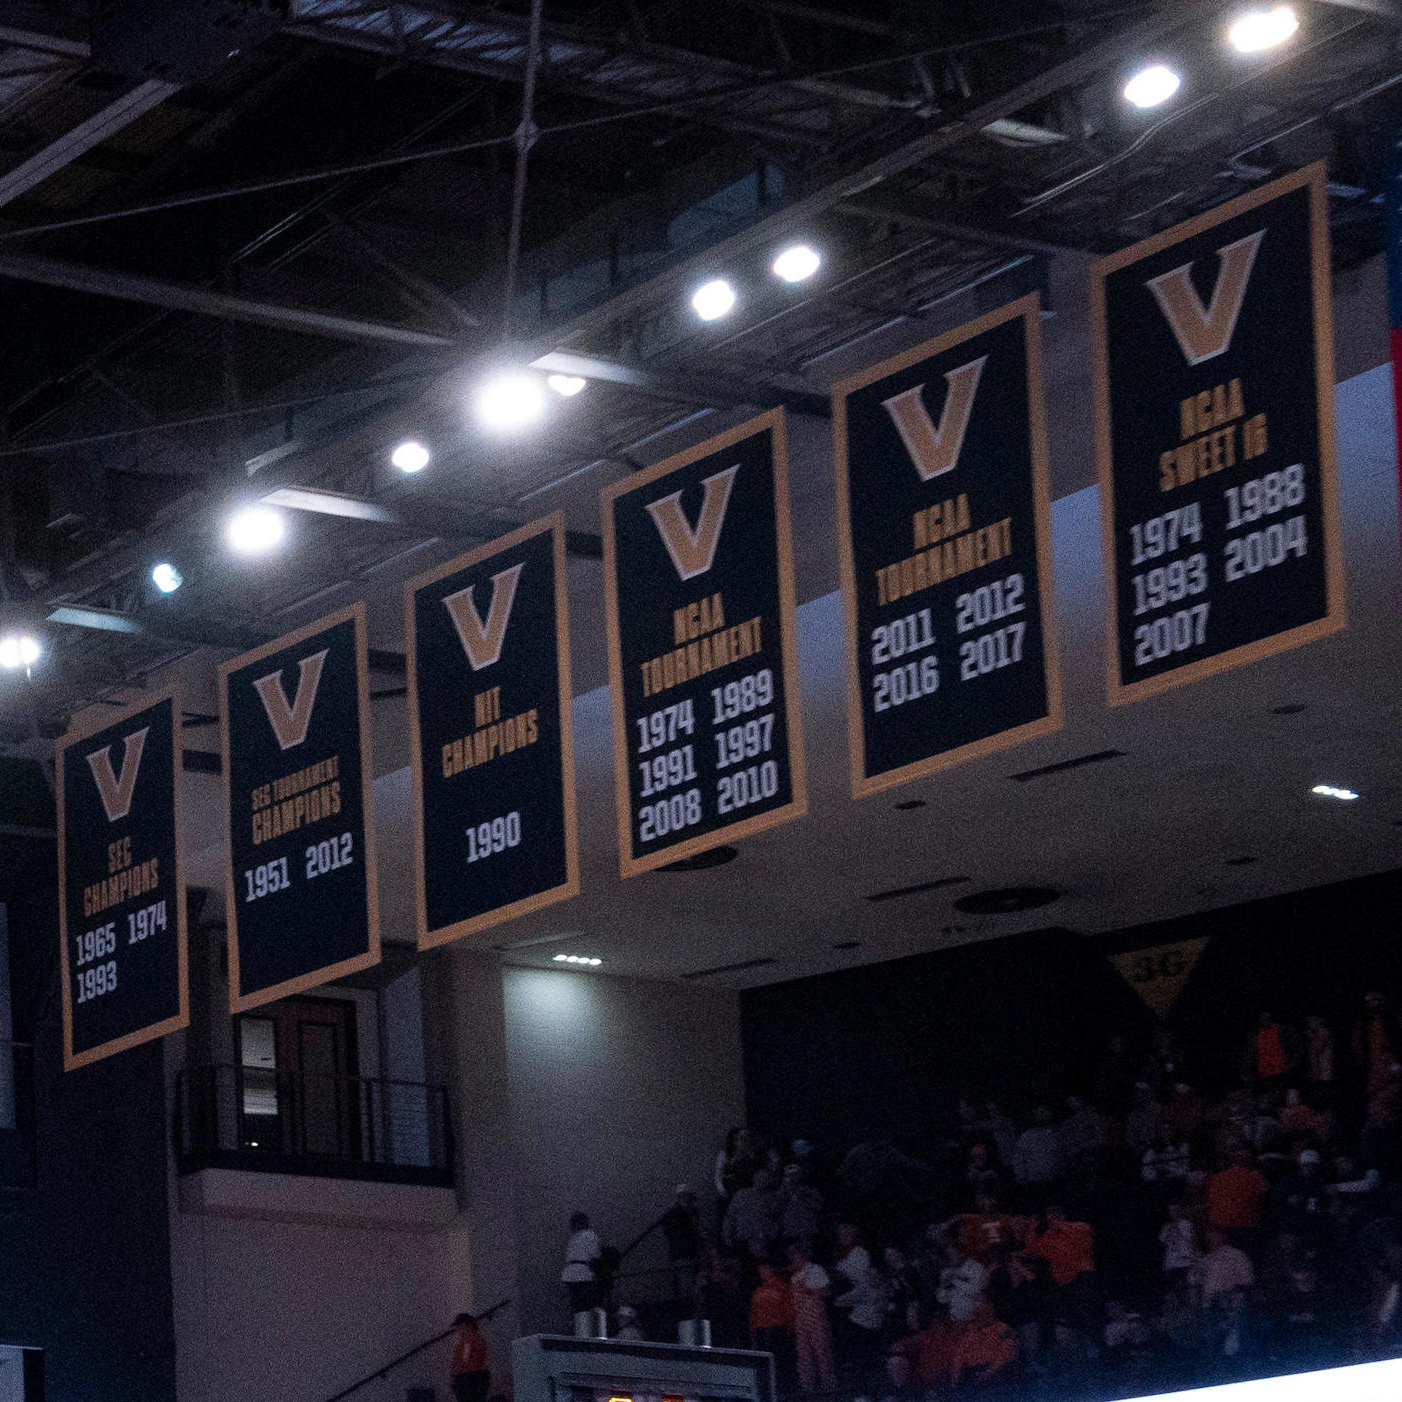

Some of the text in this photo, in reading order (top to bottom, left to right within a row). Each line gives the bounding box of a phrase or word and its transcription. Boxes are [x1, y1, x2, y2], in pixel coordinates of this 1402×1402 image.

[1145, 228, 1268, 367] V
[880, 355, 990, 482] V
[1180, 377, 1245, 440] NCAA
[1159, 426, 1236, 492] SWEET
[644, 463, 742, 582] V
[913, 494, 971, 550] NCAA
[1131, 463, 1306, 565] 1974 1988
[876, 517, 1012, 606] TOURNAMENT
[1132, 515, 1309, 616] 1993 2004
[441, 561, 525, 671] V
[641, 616, 762, 697] TOURNAMENT
[673, 593, 724, 645] NCAA
[871, 573, 1026, 666] 2011 2012
[1135, 603, 1210, 666] 2007
[252, 648, 330, 751] V
[474, 685, 501, 727] NIT
[873, 622, 1027, 713] 2016 2017
[442, 708, 538, 778] CHAMPIONS
[637, 669, 774, 753] 1974 1989
[85, 726, 150, 823] V
[639, 714, 775, 797] 1991 1997
[252, 781, 342, 845] CHAMPIONS
[466, 811, 521, 864] 1990
[640, 760, 778, 842] 2008 2010
[84, 857, 159, 917] CHAMPIONS
[108, 836, 132, 876] SEC
[244, 832, 353, 902] 1951 2012
[76, 900, 167, 966] 1965 1974
[77, 960, 117, 1003] 1993
